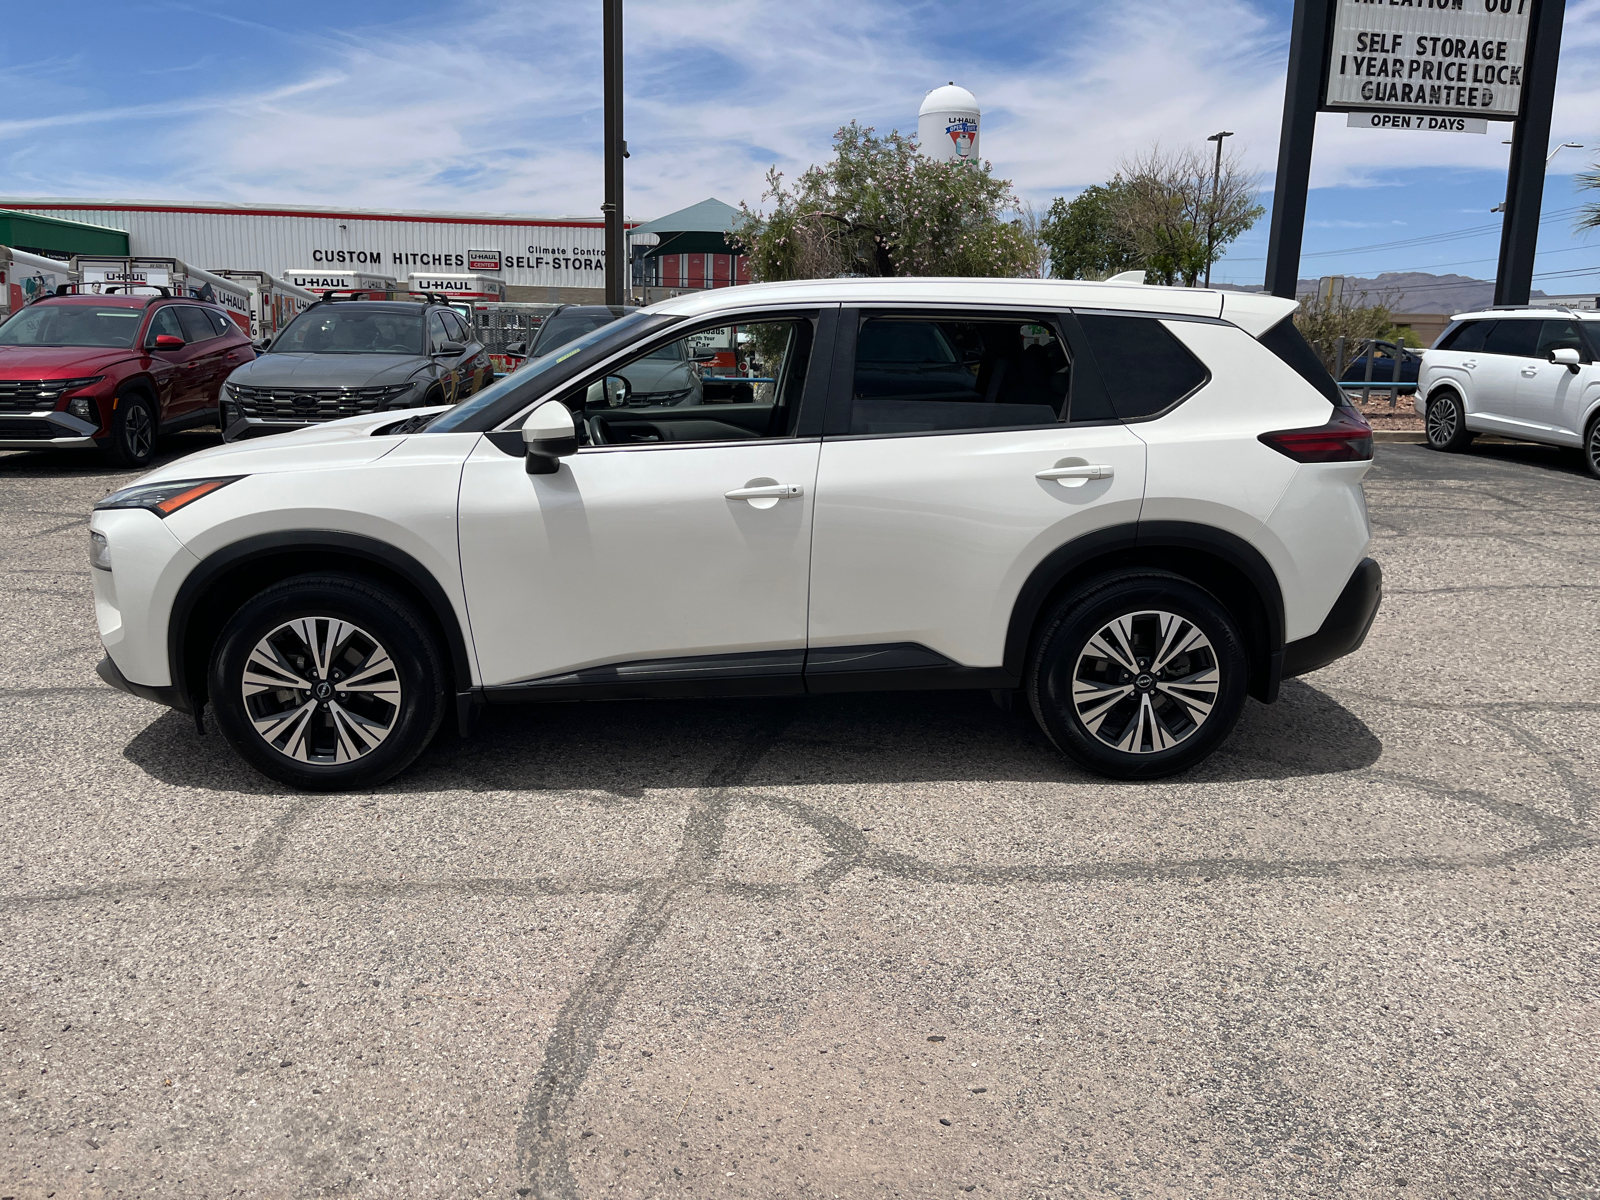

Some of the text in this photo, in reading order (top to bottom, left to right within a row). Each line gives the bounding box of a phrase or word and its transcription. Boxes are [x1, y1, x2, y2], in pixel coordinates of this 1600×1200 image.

[1356, 32, 1508, 61] SELF STORAGE
[1353, 56, 1404, 78] YEAR
[1408, 59, 1468, 82] PRICE
[1472, 64, 1522, 86] LOCK
[1360, 81, 1494, 107] GUARANTEED
[949, 117, 977, 125] U-HAUL
[1371, 115, 1465, 130] OPEN 7 DAYS
[312, 250, 464, 266] CUSTOM HITCHES
[528, 246, 567, 255] Climate
[505, 256, 605, 271] SELF-STORA
[106, 273, 146, 281] U-HAUL
[294, 277, 349, 288] U-HAUL
[419, 281, 472, 290] U-HAUL
[219, 291, 247, 312] U-HAUL
